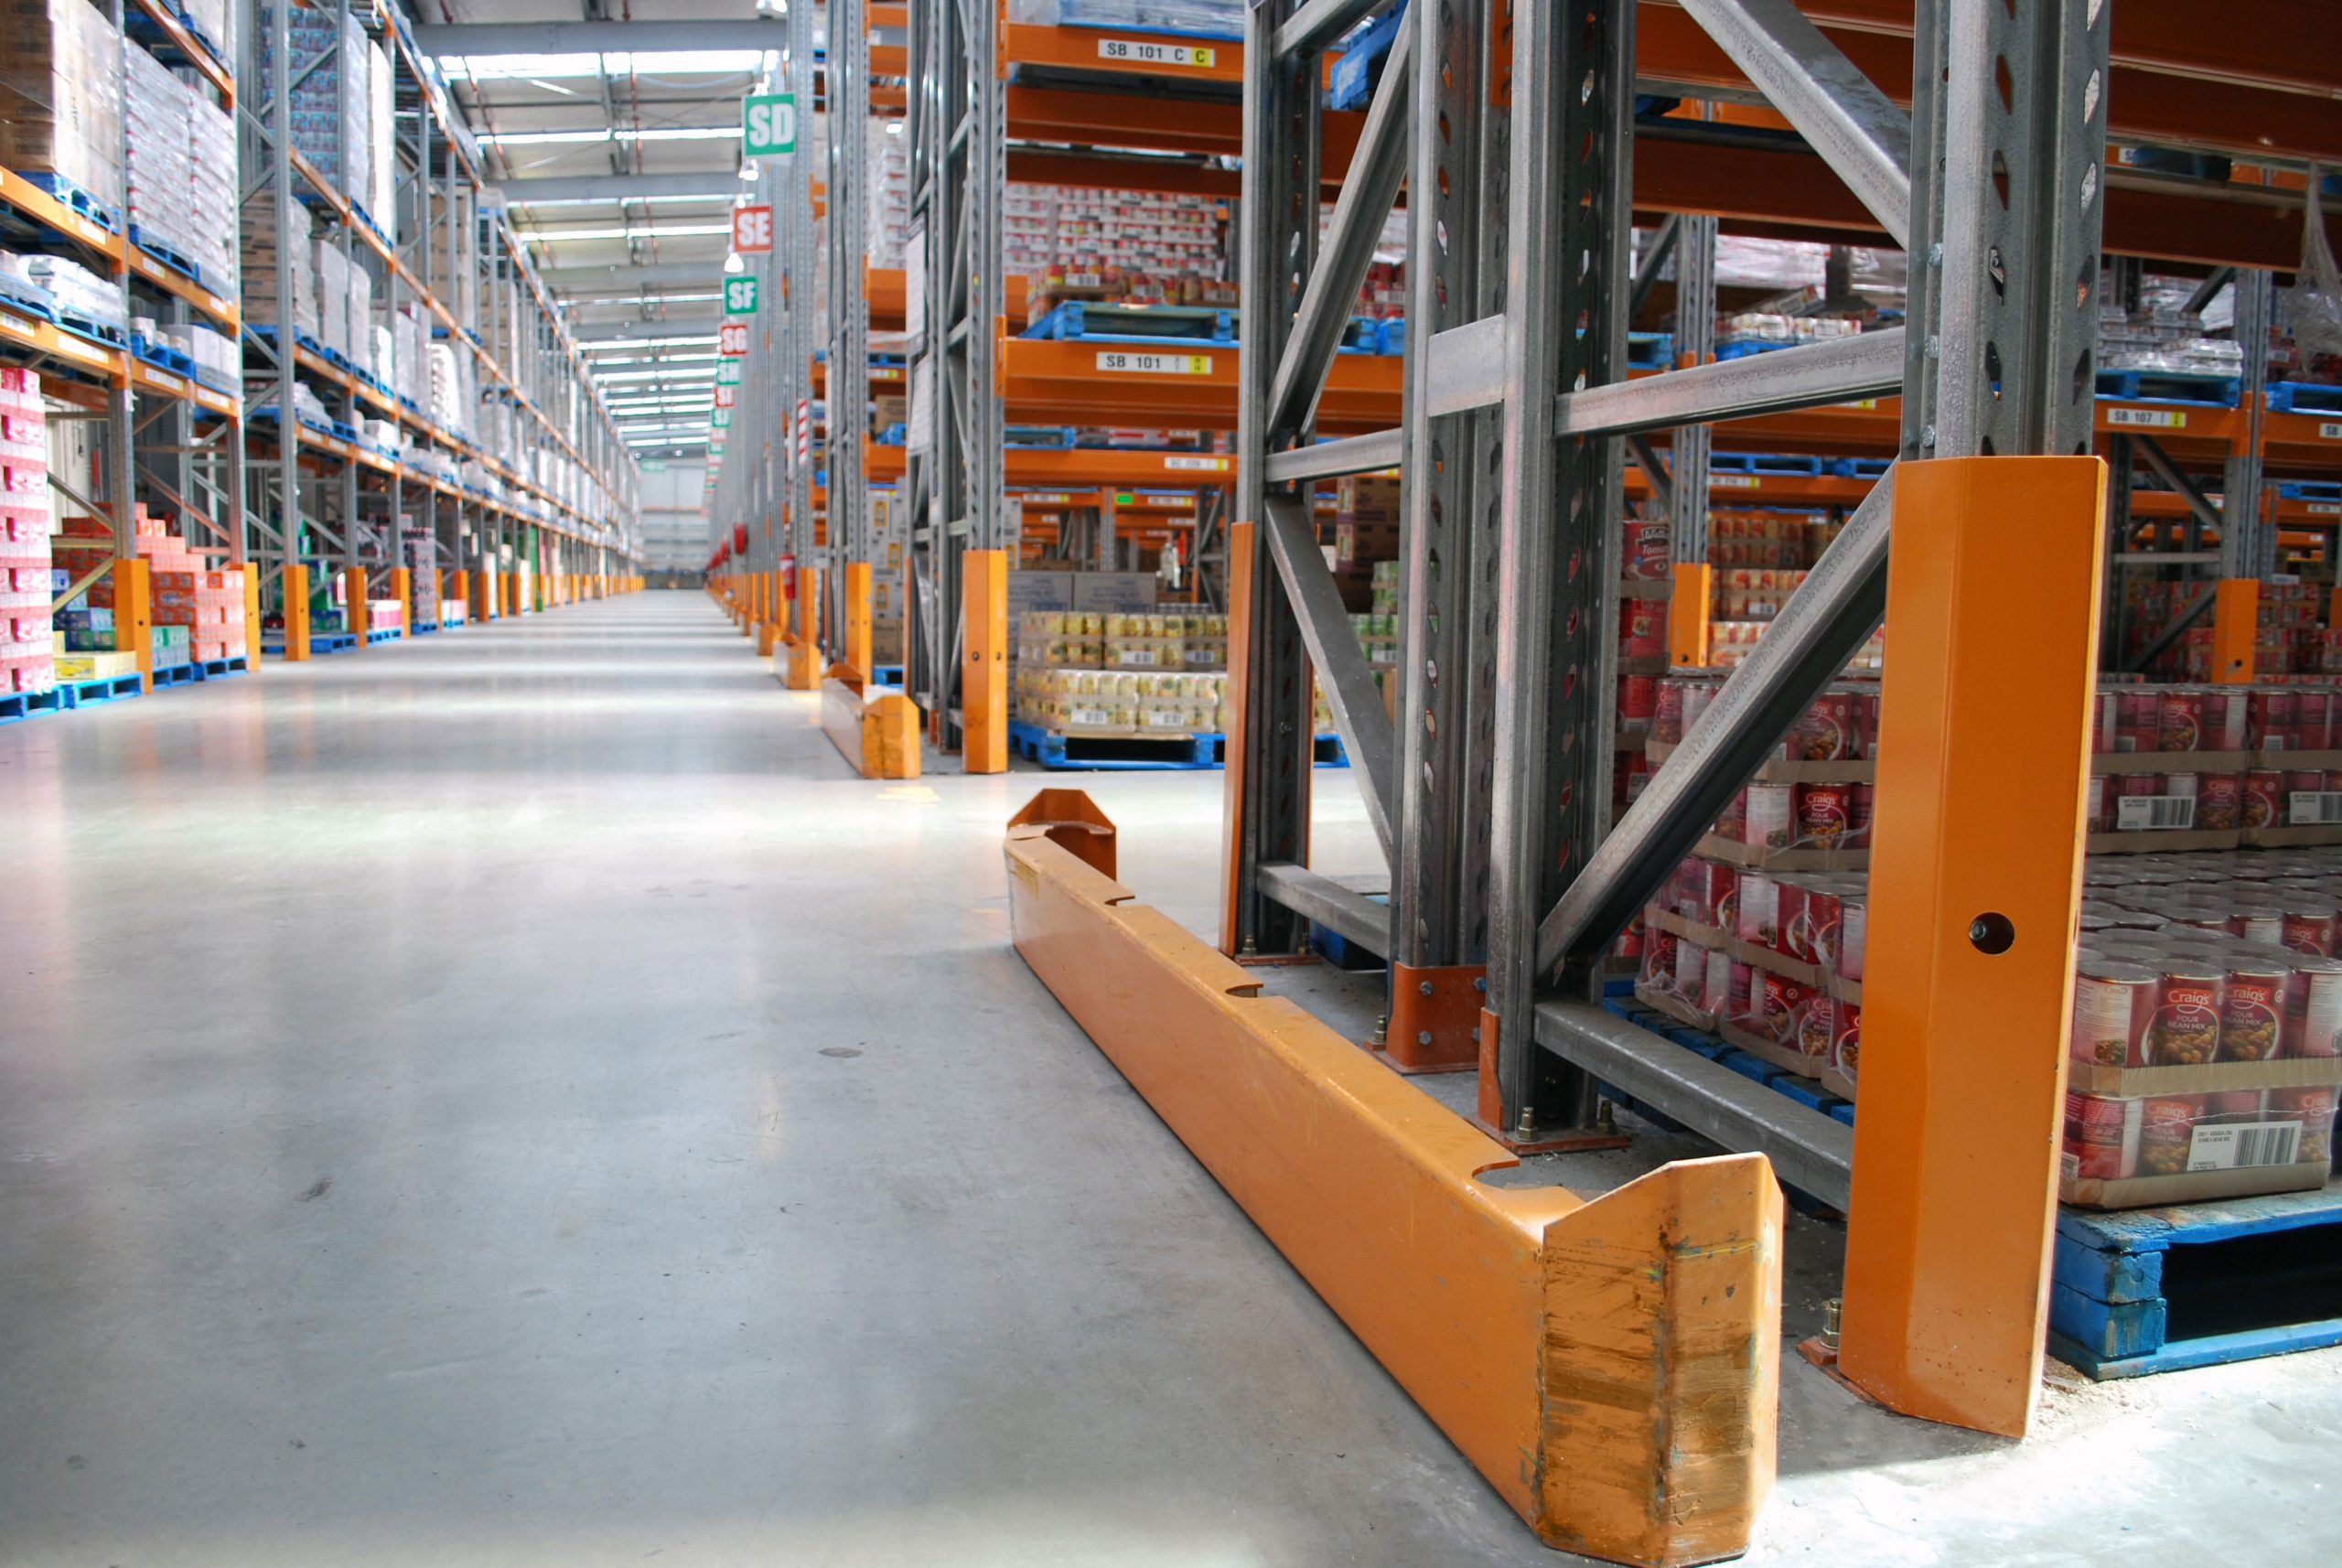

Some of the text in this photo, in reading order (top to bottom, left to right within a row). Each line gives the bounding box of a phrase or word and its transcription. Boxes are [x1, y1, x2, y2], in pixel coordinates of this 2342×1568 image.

[1107, 42, 1205, 63] SB 101 C C
[747, 102, 795, 146] SD
[737, 211, 771, 247] SE
[728, 281, 756, 309] SF
[722, 327, 747, 353] SG
[1106, 355, 1126, 368] SB
[1136, 357, 1161, 370] 101
[2114, 410, 2128, 422] SB
[2134, 412, 2153, 423] 107
[2167, 990, 2210, 1007] Craig's
[2176, 1015, 2199, 1023] FOUR
[2145, 1101, 2187, 1118] Craig's
